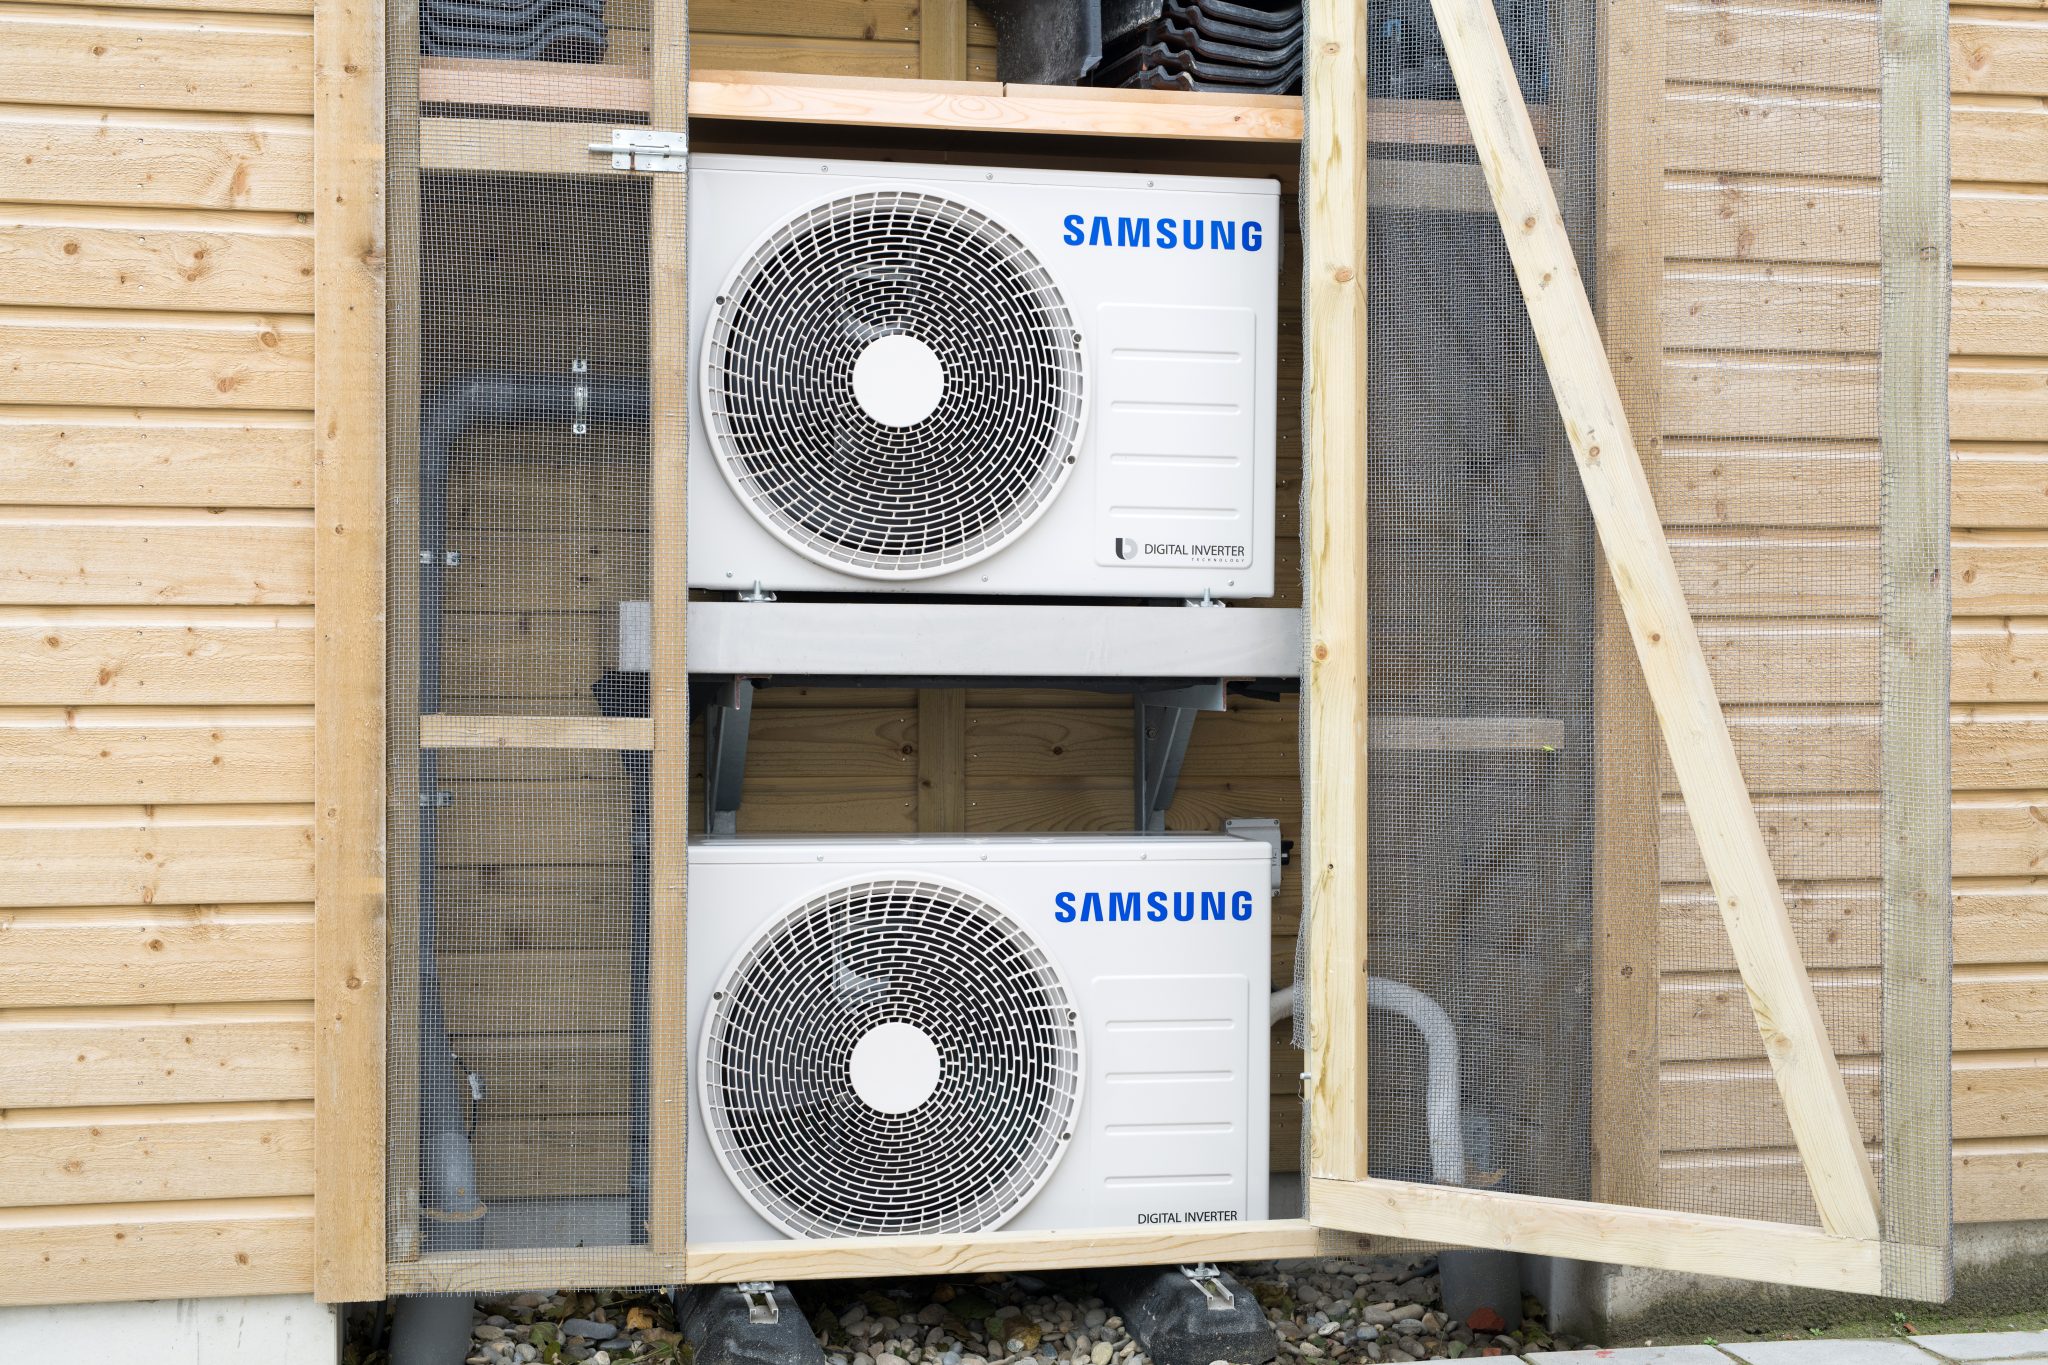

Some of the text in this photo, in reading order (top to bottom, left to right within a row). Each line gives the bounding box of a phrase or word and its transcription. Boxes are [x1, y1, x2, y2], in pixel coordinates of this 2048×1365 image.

[1063, 214, 1263, 252] SAMSUNG
[1145, 543, 1245, 557] DIGITAL INVERTER
[1055, 890, 1253, 923] SAMSUNG
[1137, 1210, 1238, 1225] DIGITAL INVERTER
